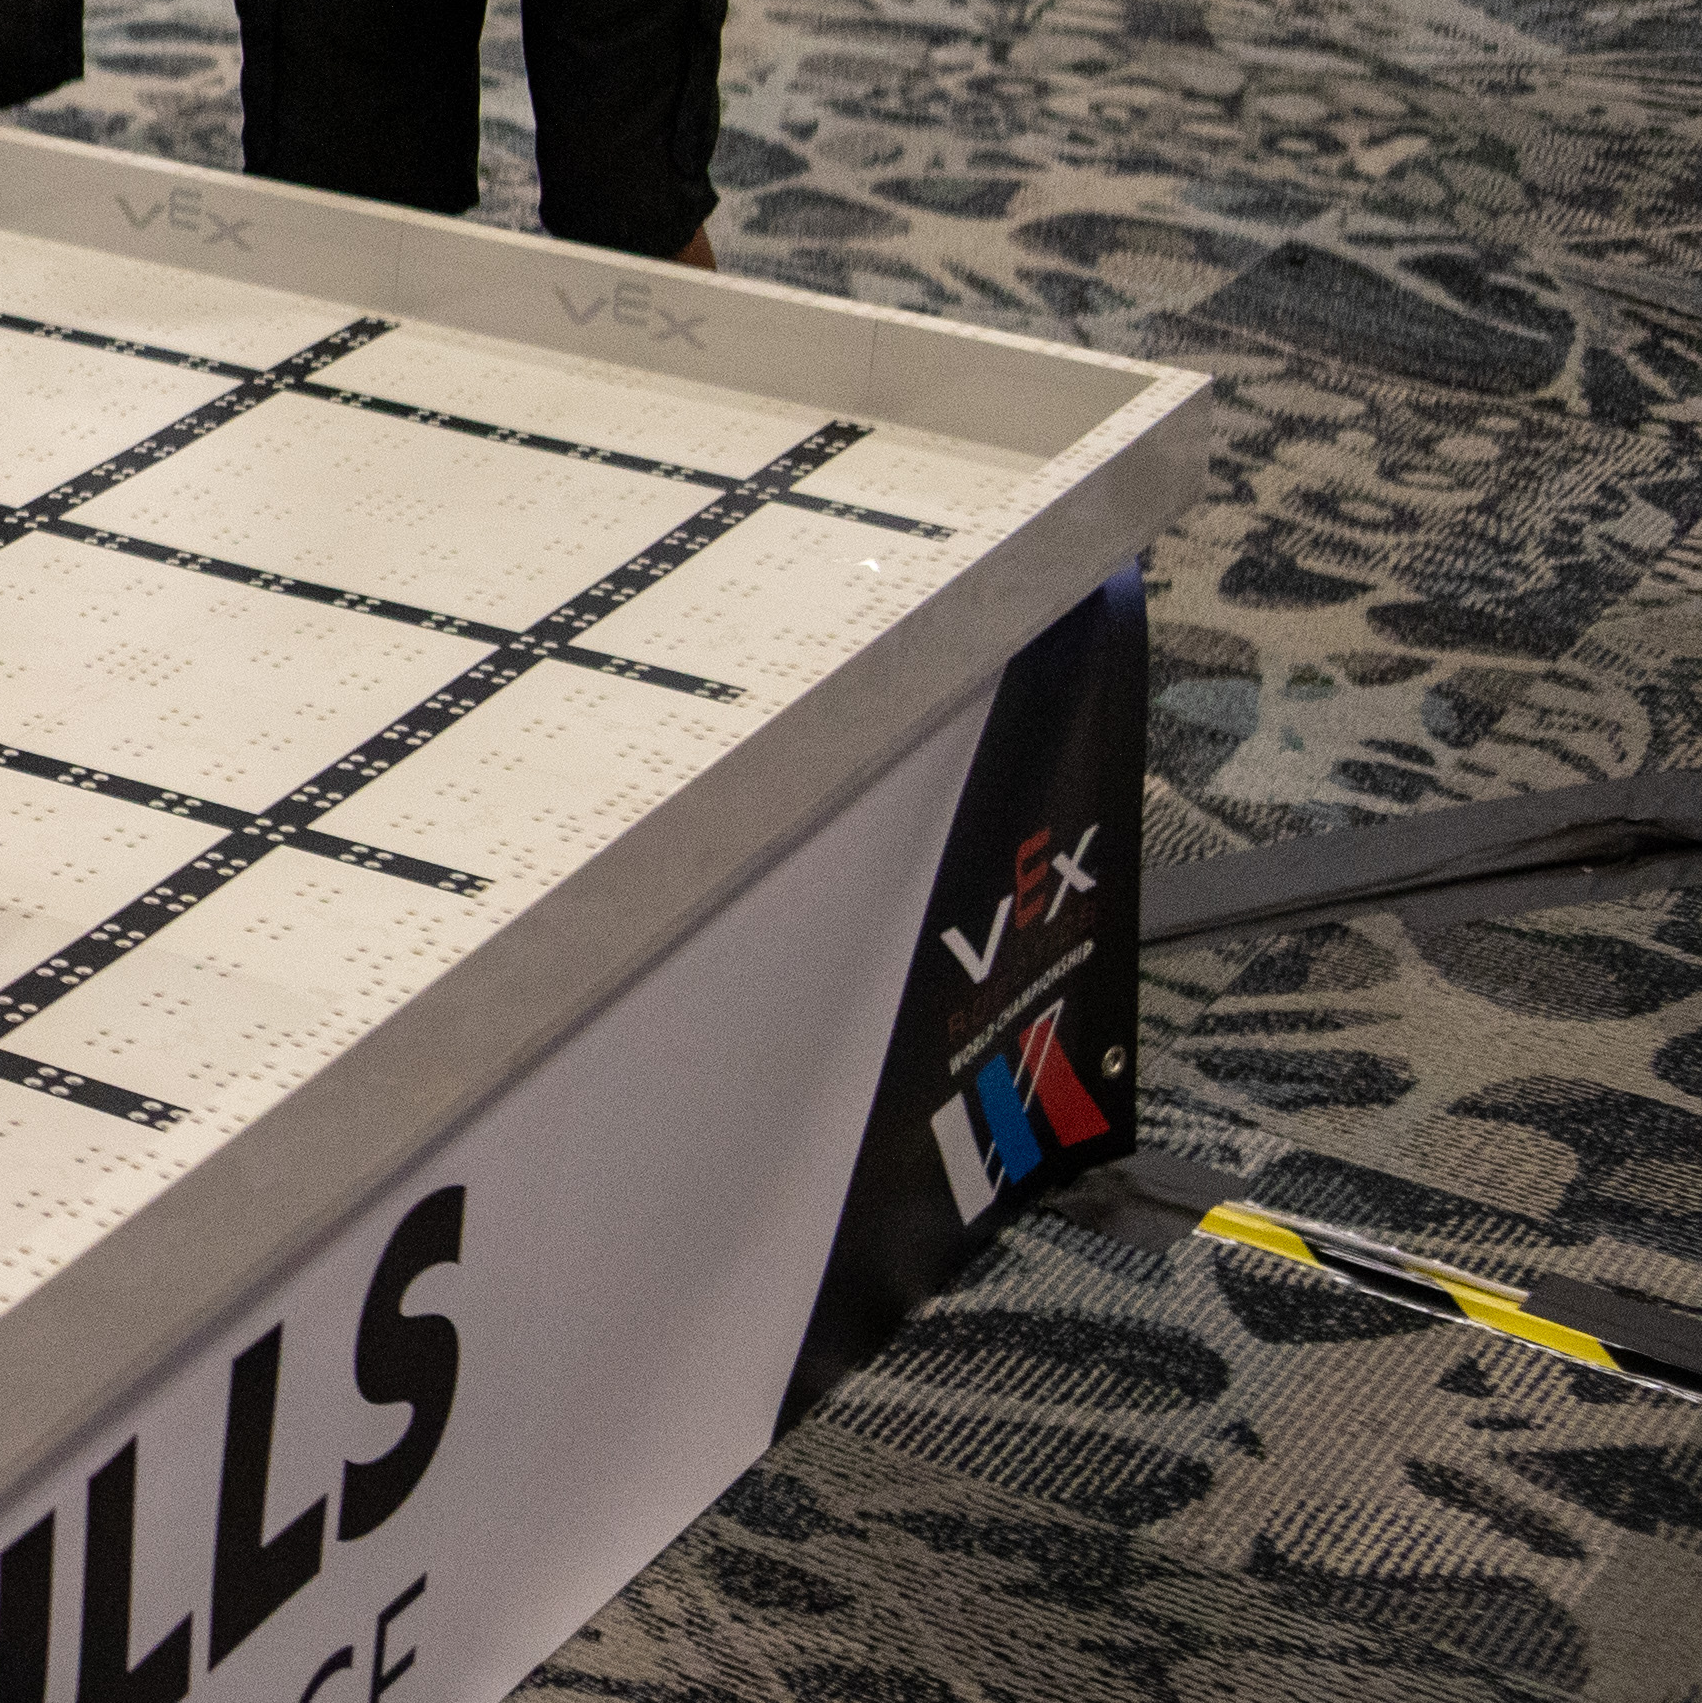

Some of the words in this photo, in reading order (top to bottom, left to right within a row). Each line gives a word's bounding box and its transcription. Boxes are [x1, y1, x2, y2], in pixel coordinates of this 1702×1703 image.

[114, 186, 253, 249] VEX
[553, 282, 709, 350] VEX
[939, 821, 1100, 986] VEX
[994, 937, 1097, 1034] CHAMPIONSHIP
